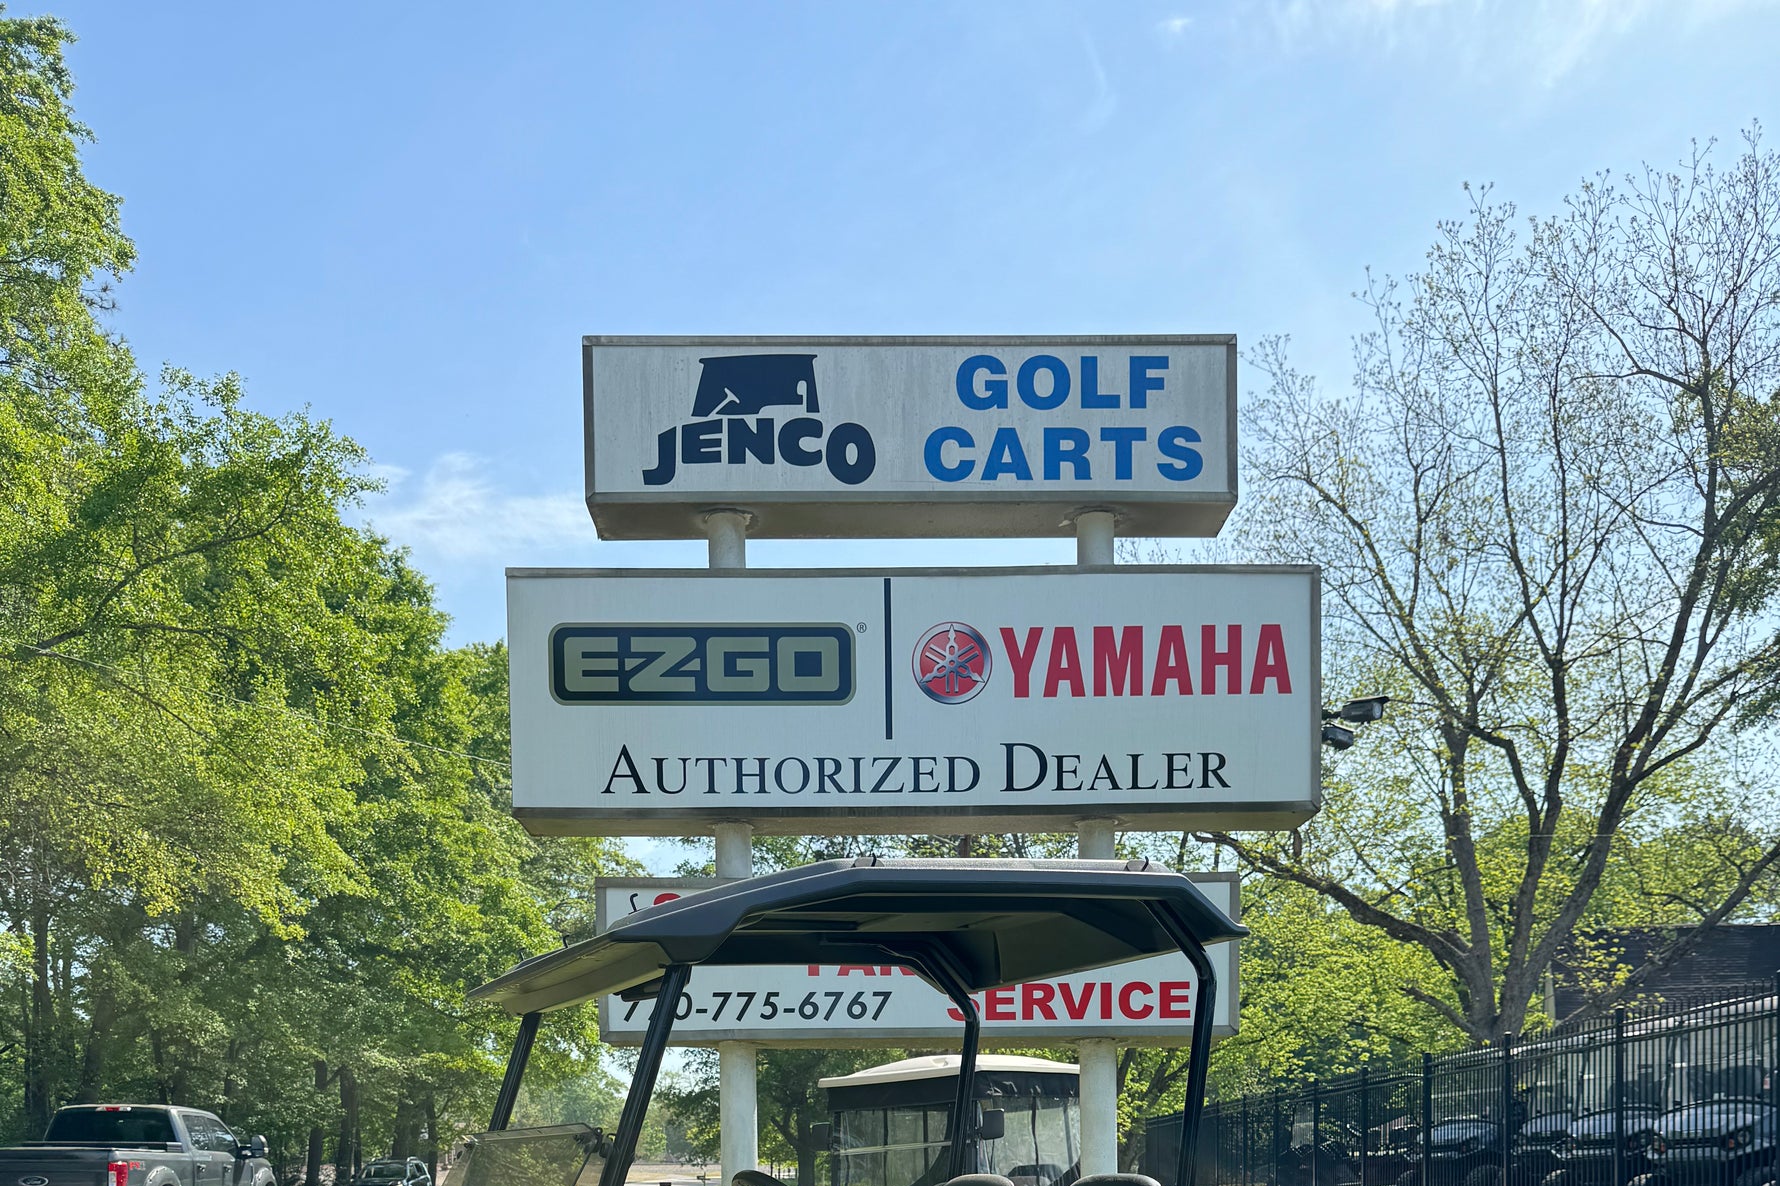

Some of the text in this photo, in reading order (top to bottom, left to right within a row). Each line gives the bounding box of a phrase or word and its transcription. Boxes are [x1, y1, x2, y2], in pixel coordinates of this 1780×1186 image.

[955, 355, 1169, 410] GOLF
[642, 417, 876, 485] JENCO
[923, 426, 1203, 482] CARTS
[999, 623, 1292, 699] YAMAHA
[601, 742, 1231, 796] AUTHORIZED DEALER
[623, 991, 892, 1022] 70-775-6767
